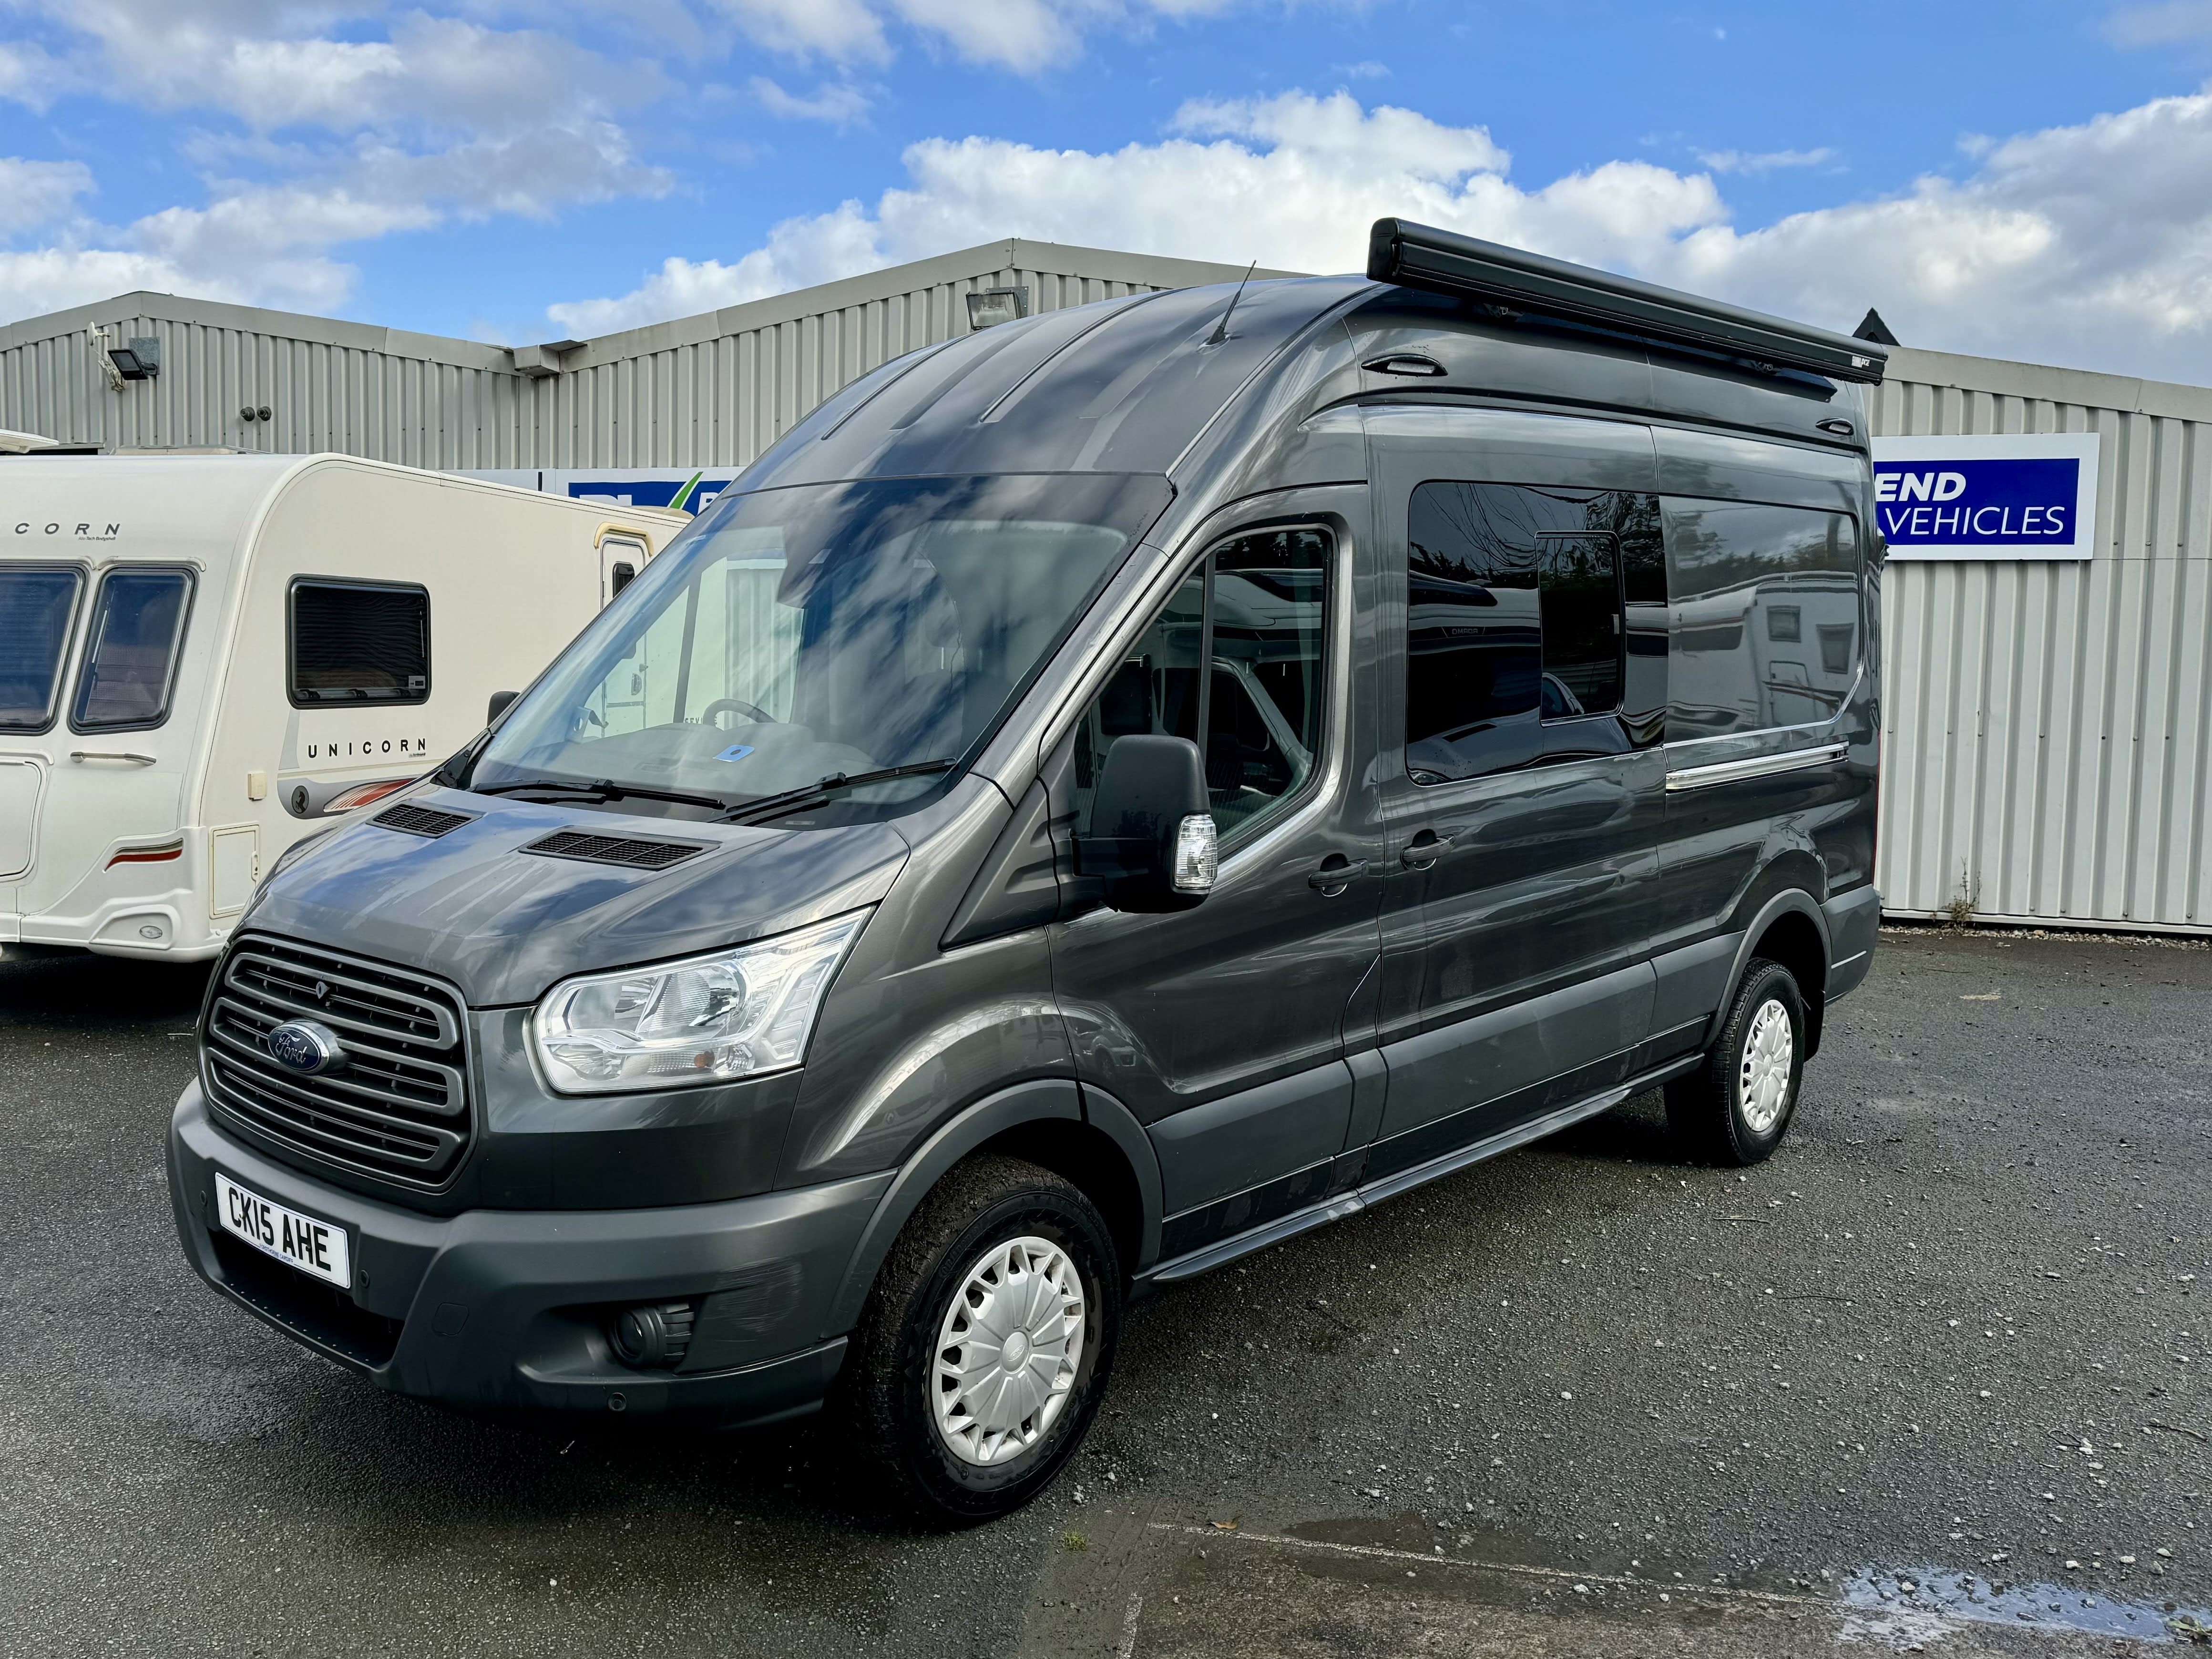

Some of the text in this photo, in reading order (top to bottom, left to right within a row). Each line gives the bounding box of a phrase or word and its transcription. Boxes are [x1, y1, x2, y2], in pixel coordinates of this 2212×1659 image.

[1874, 472, 1966, 502] END
[15, 522, 120, 535] CORN
[1885, 506, 2065, 535] VEHICLES
[308, 738, 425, 758] UNICORN
[275, 1032, 307, 1064] Ford
[228, 1187, 331, 1272] CK15 AHE
